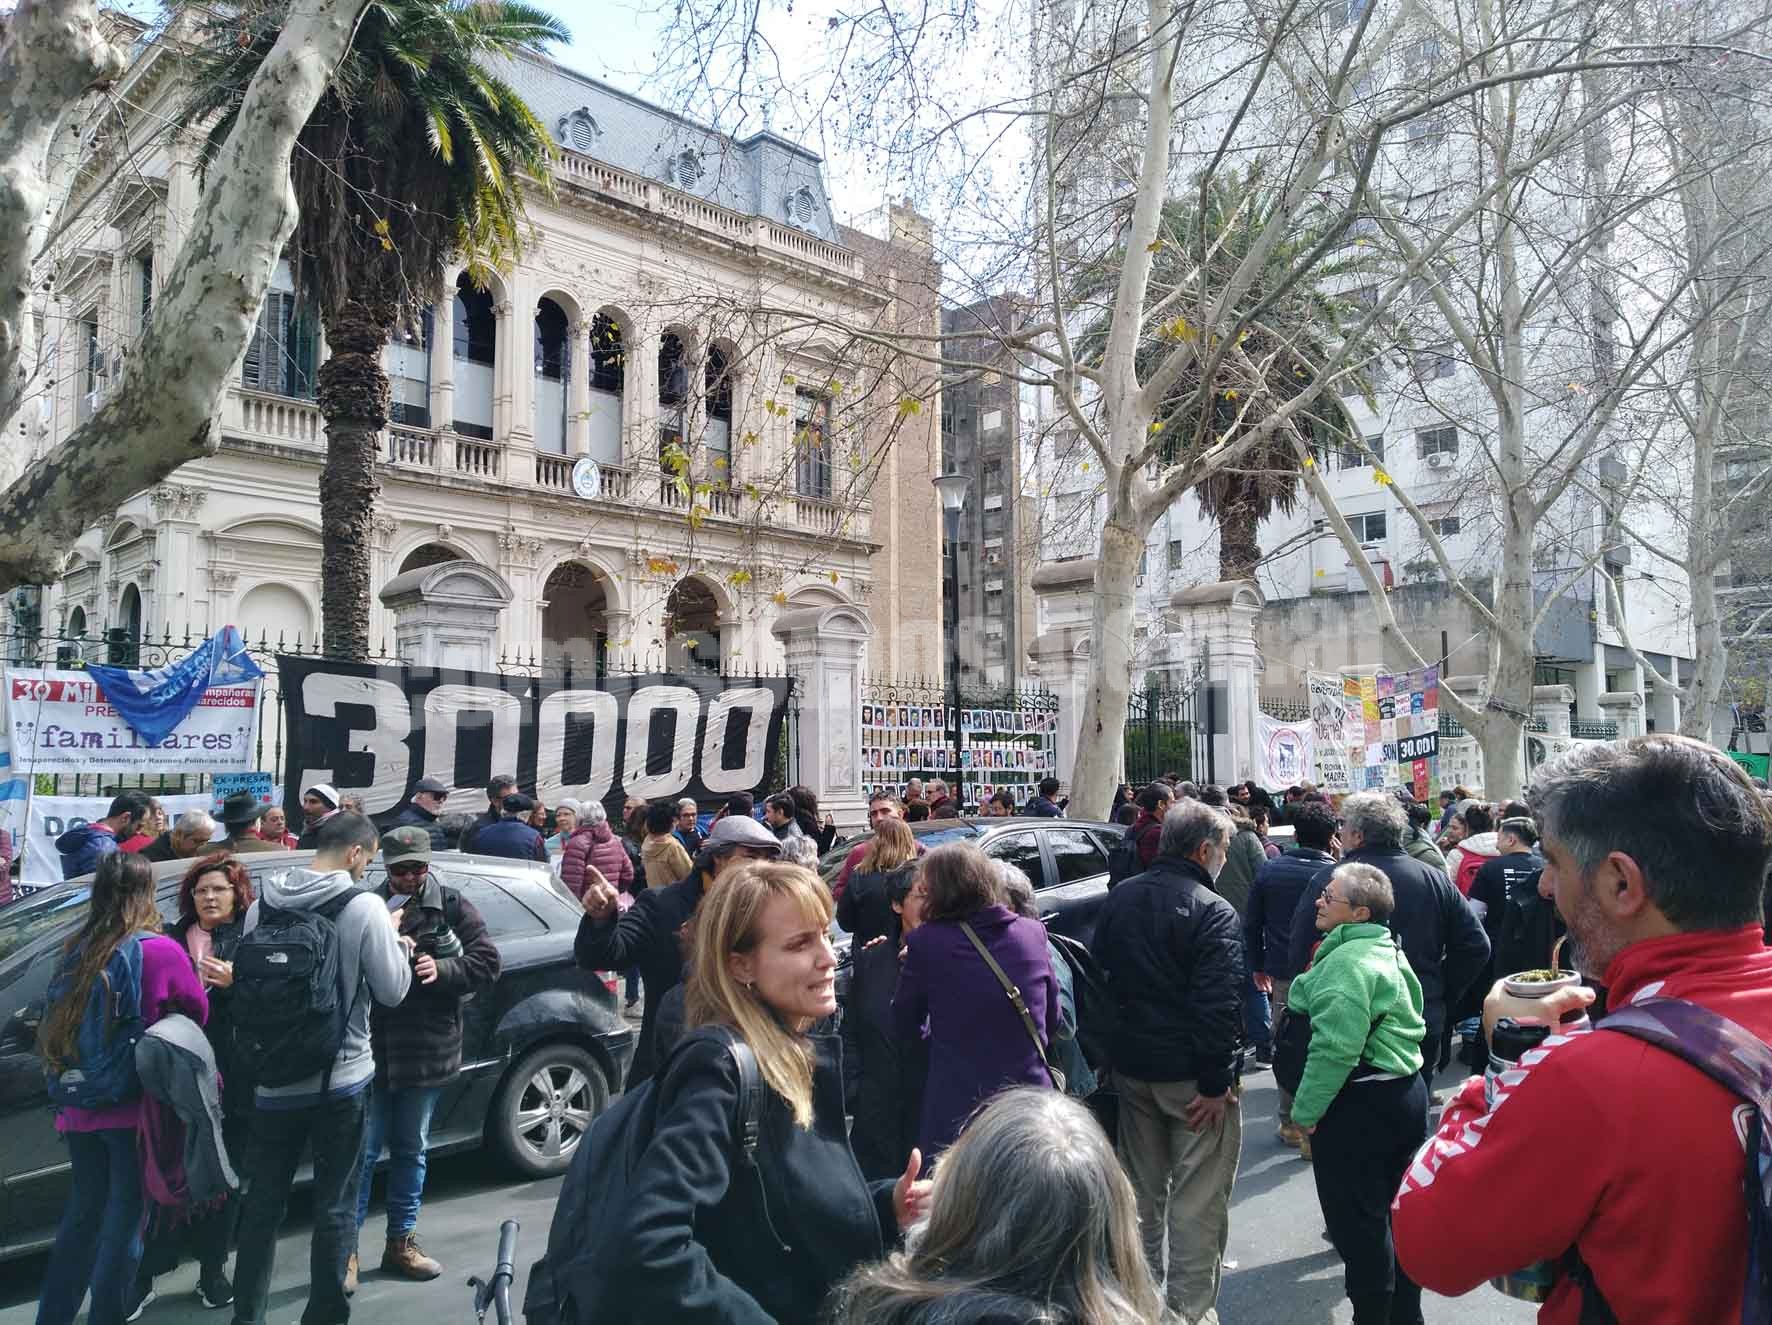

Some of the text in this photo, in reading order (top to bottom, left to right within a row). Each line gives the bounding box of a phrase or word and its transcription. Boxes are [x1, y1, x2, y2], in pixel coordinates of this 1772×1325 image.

[17, 680, 51, 701] 30
[40, 724, 232, 749] familares
[298, 672, 775, 817] 30000
